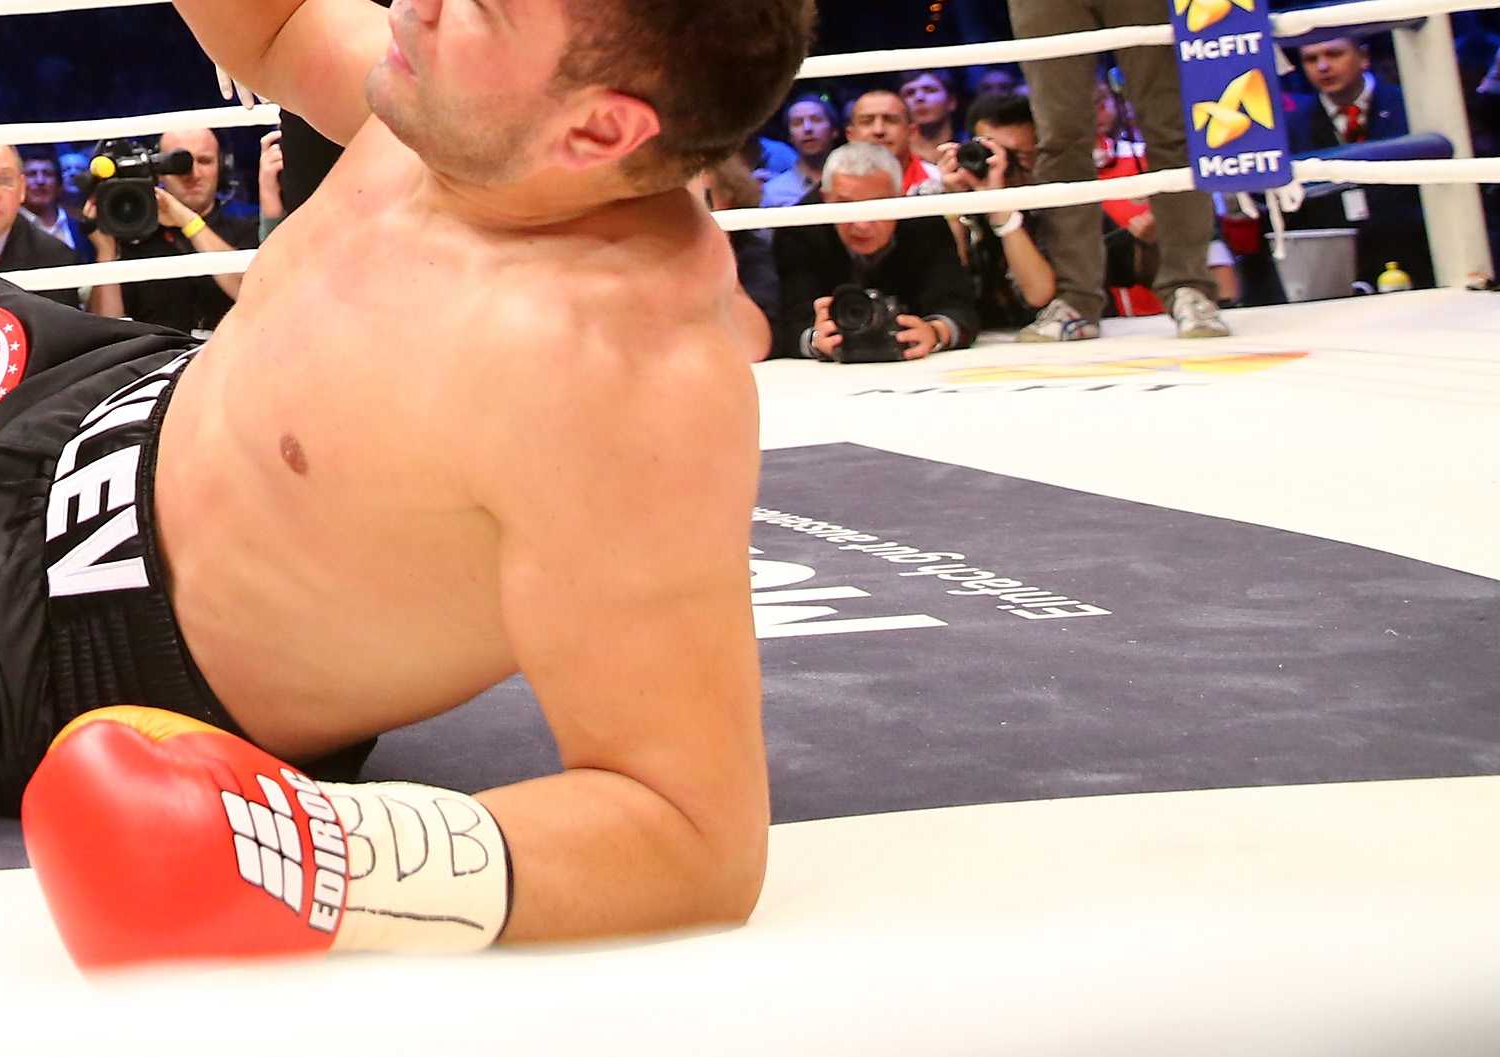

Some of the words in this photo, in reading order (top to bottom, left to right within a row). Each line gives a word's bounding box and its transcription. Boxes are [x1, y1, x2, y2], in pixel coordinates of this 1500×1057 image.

[1181, 31, 1262, 62] McFIT
[1200, 150, 1282, 178] McFIT
[838, 541, 966, 564] gut
[898, 563, 1113, 620] Einfach
